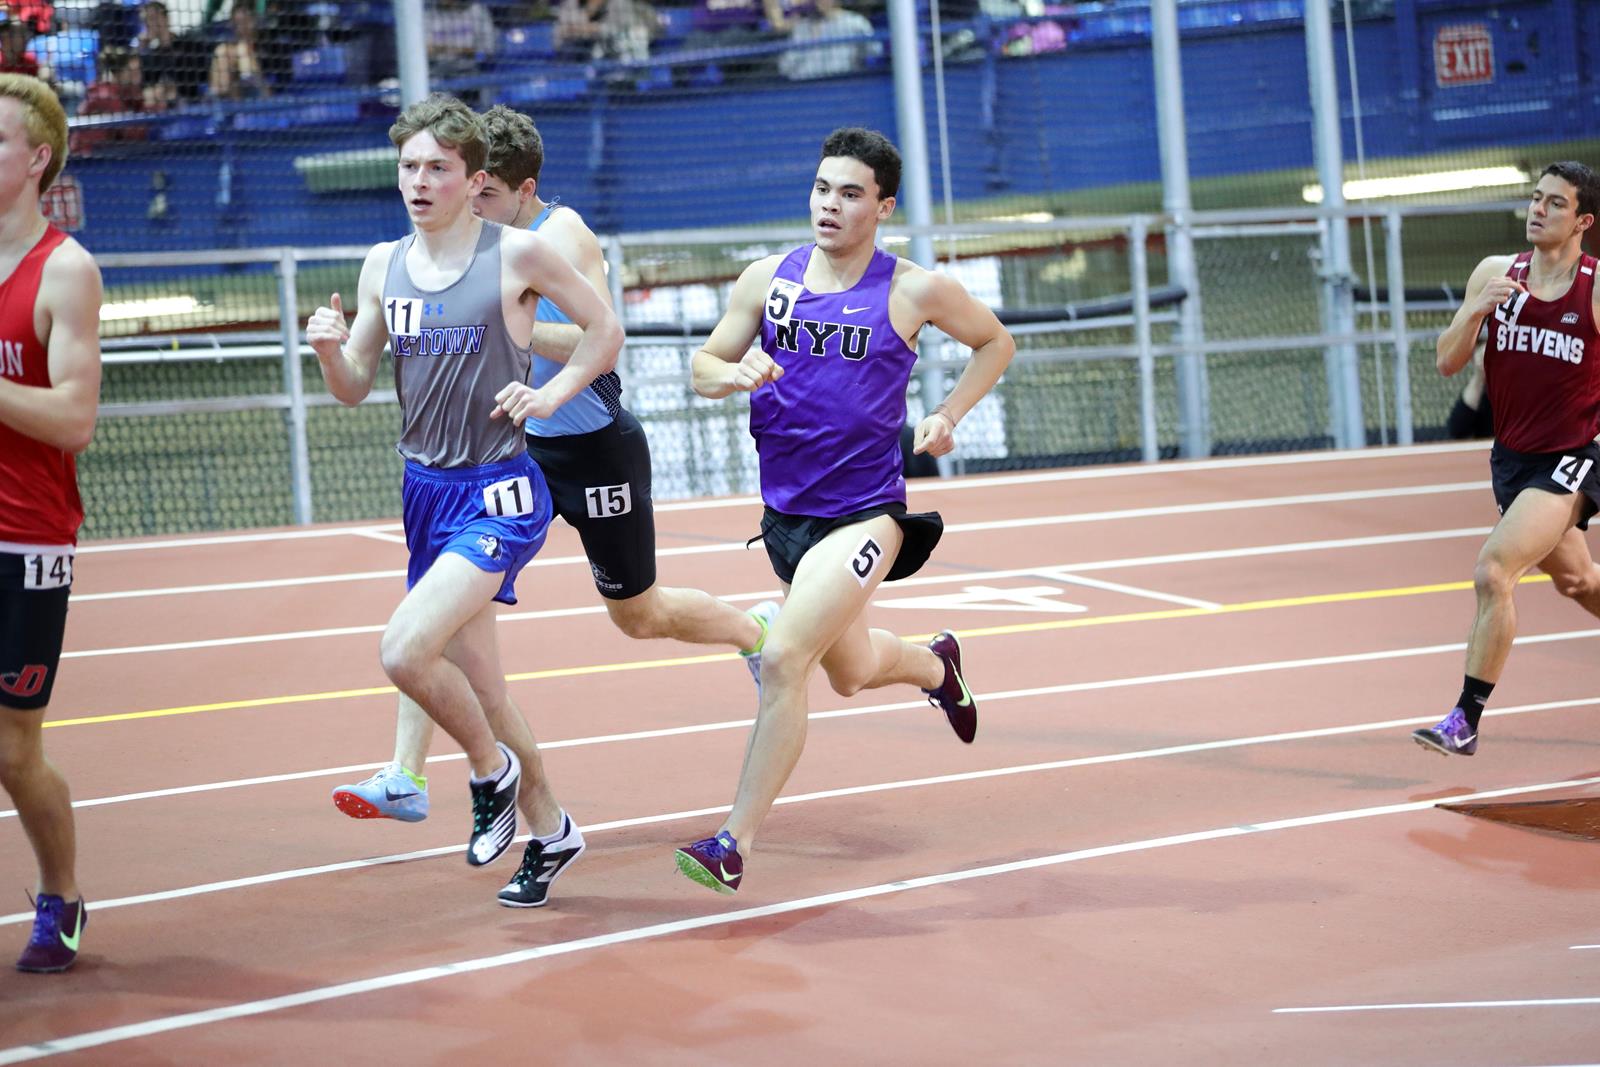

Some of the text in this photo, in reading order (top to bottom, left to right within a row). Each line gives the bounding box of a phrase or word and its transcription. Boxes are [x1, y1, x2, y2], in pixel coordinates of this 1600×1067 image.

[1440, 42, 1488, 77] EXIT
[388, 300, 412, 333] 11
[769, 287, 789, 320] 5
[1499, 288, 1520, 321] 4
[775, 319, 872, 361] NYU
[1497, 324, 1584, 365] STEVENS
[1560, 458, 1584, 486] 4
[493, 481, 522, 516] 11
[590, 487, 625, 516] 15
[30, 555, 66, 586] 14
[853, 539, 881, 578] 5
